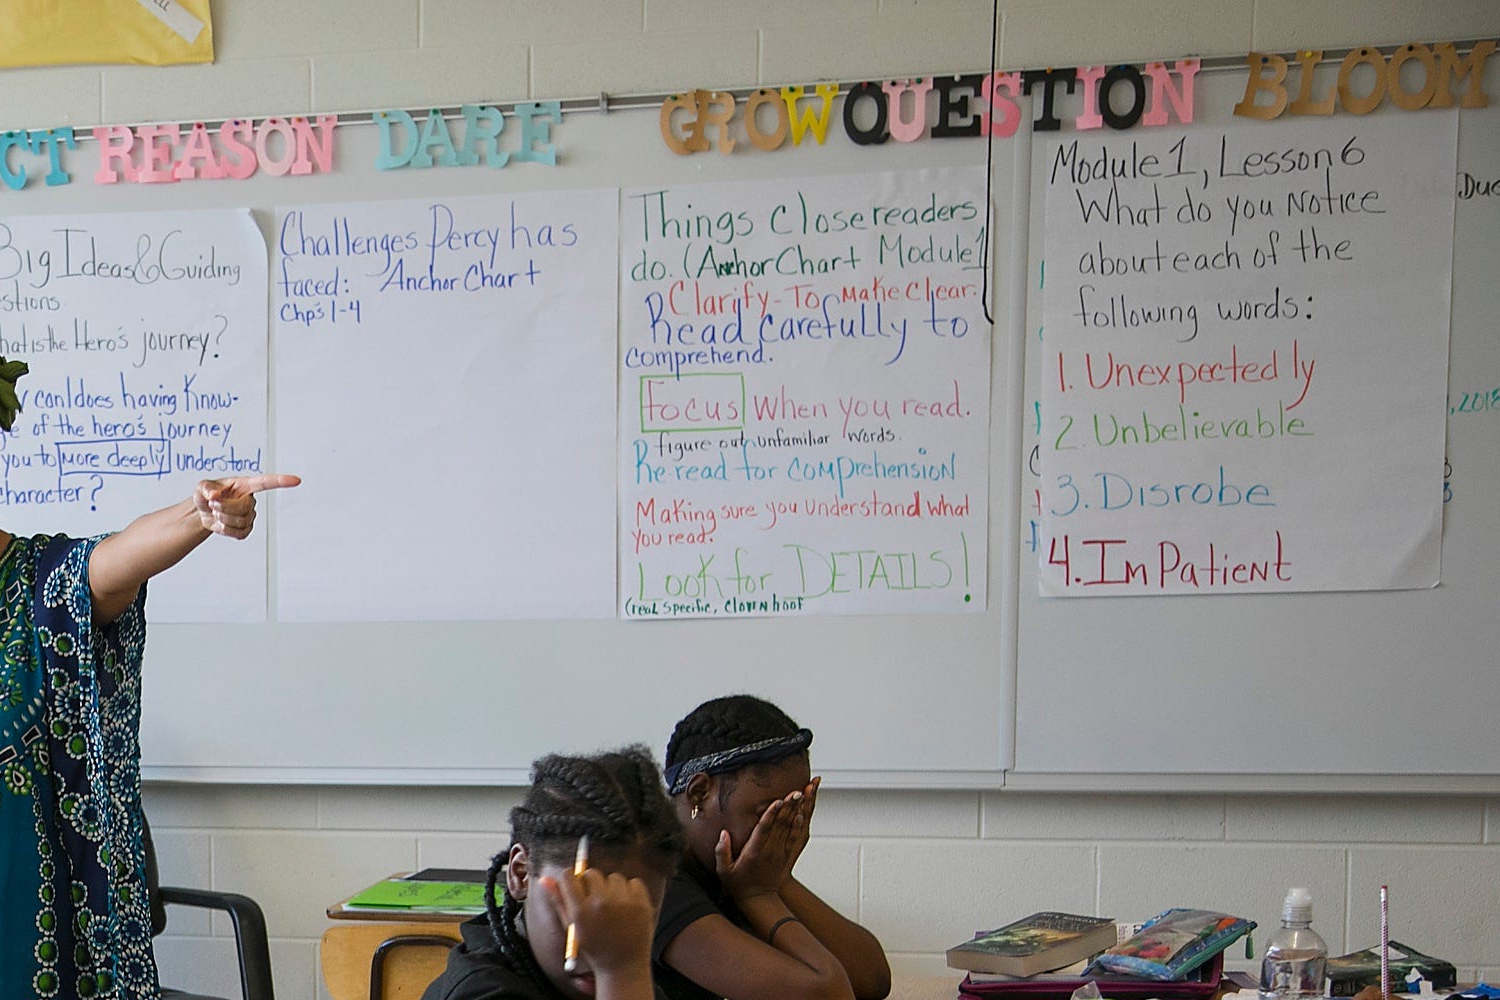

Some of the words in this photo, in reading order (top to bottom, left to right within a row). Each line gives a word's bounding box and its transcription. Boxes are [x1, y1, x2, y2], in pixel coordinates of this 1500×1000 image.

[94, 114, 338, 184] REASON
[373, 101, 561, 172] DARE
[660, 83, 839, 156] GROW
[843, 59, 1201, 146] QUESTION
[1233, 41, 1497, 121] BLOOM
[1051, 139, 1159, 185] Module
[1219, 134, 1332, 178] Lesson
[1341, 136, 1365, 166] 6
[628, 190, 754, 245] Things
[872, 193, 978, 225] readers
[1075, 180, 1167, 228] What
[1176, 184, 1212, 225] do
[1226, 197, 1275, 235] you
[53, 229, 135, 279] Ideas
[159, 230, 241, 286] Guiding
[280, 211, 418, 276] Challenges
[426, 203, 500, 270] Percy
[511, 200, 578, 250] has
[776, 244, 861, 275] Chart
[879, 234, 973, 269] Module
[1079, 240, 1172, 277] about
[1172, 238, 1241, 273] each
[1253, 230, 1279, 268] of
[1293, 226, 1354, 263] the
[277, 257, 350, 298] faced:
[380, 258, 462, 292] Anchor
[464, 259, 542, 292] Chart
[645, 292, 753, 347] Read
[923, 290, 968, 339] to
[1072, 285, 1198, 343] following
[1217, 287, 1313, 321] words:
[44, 325, 67, 352] the
[74, 317, 129, 352] Hero's
[133, 315, 229, 368] journey?
[120, 372, 177, 416] having
[1058, 352, 1073, 392] 1.
[1086, 338, 1316, 411] Unexpectedly
[32, 413, 50, 436] of
[52, 413, 85, 437] the
[91, 414, 147, 439] hero's
[157, 412, 232, 453] journey
[643, 380, 739, 422] Focus
[839, 396, 890, 438] you
[902, 379, 971, 418] read.
[1093, 400, 1314, 446] Unbelievable
[1, 453, 32, 478] you
[34, 444, 57, 468] to
[107, 442, 165, 480] deeply
[176, 446, 263, 474] understand
[655, 431, 712, 462] figure
[719, 430, 745, 449] out
[757, 427, 830, 448] unfamiliar
[734, 439, 778, 481] for
[636, 497, 717, 533] Making
[721, 503, 757, 520] sure
[758, 502, 798, 530] you
[1052, 475, 1089, 516] 3.
[1094, 465, 1277, 509] Disrobe
[638, 553, 724, 601] Look
[725, 548, 772, 591] for
[1049, 534, 1082, 587] 4.
